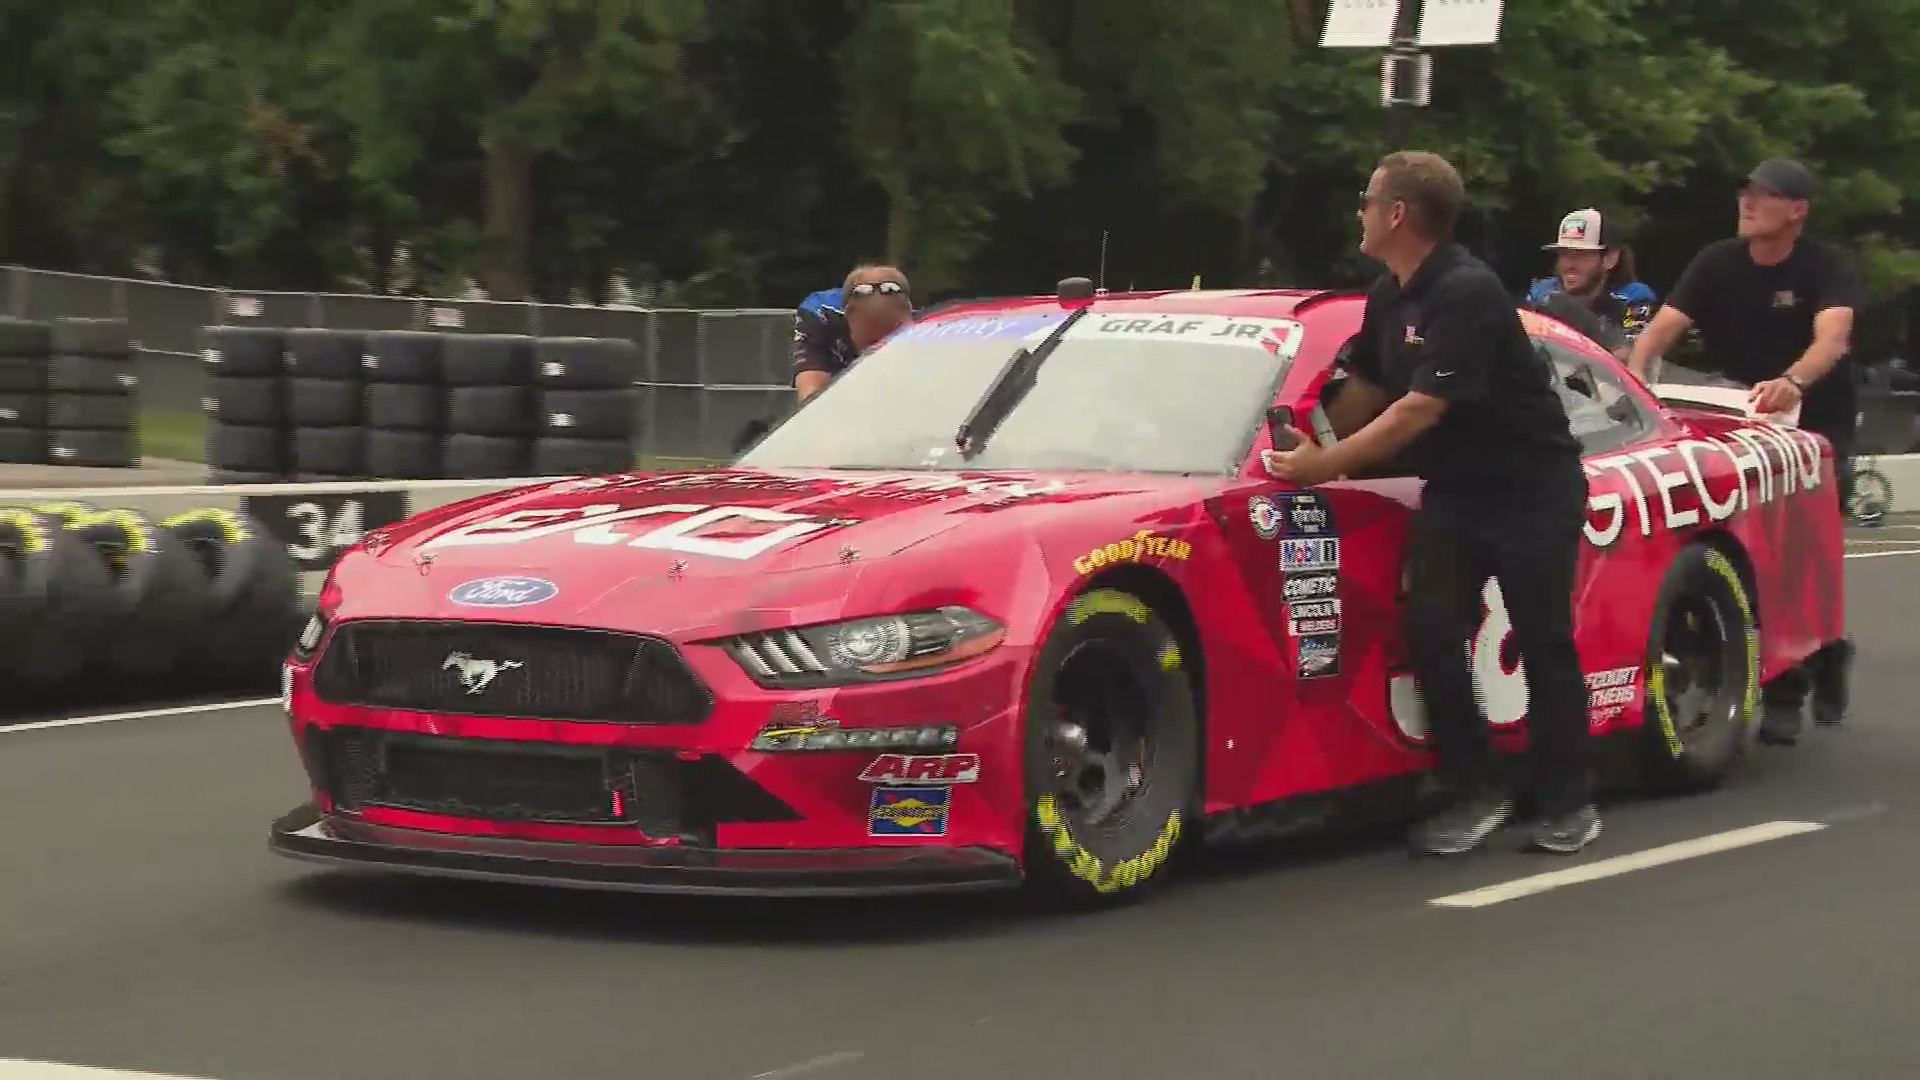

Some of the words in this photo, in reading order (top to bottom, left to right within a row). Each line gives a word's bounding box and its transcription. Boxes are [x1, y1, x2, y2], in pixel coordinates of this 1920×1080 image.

[1099, 318, 1202, 336] GRAF
[1210, 320, 1263, 340] JR
[286, 500, 364, 560] 34
[1073, 529, 1192, 575] GOODYEAR
[1283, 541, 1321, 564] Mobil
[464, 579, 541, 602] Ford
[1284, 576, 1337, 597] COMETIC
[1291, 603, 1334, 619] LINCOLN
[862, 753, 979, 783] ARP
[875, 803, 944, 821] SUNOCO
